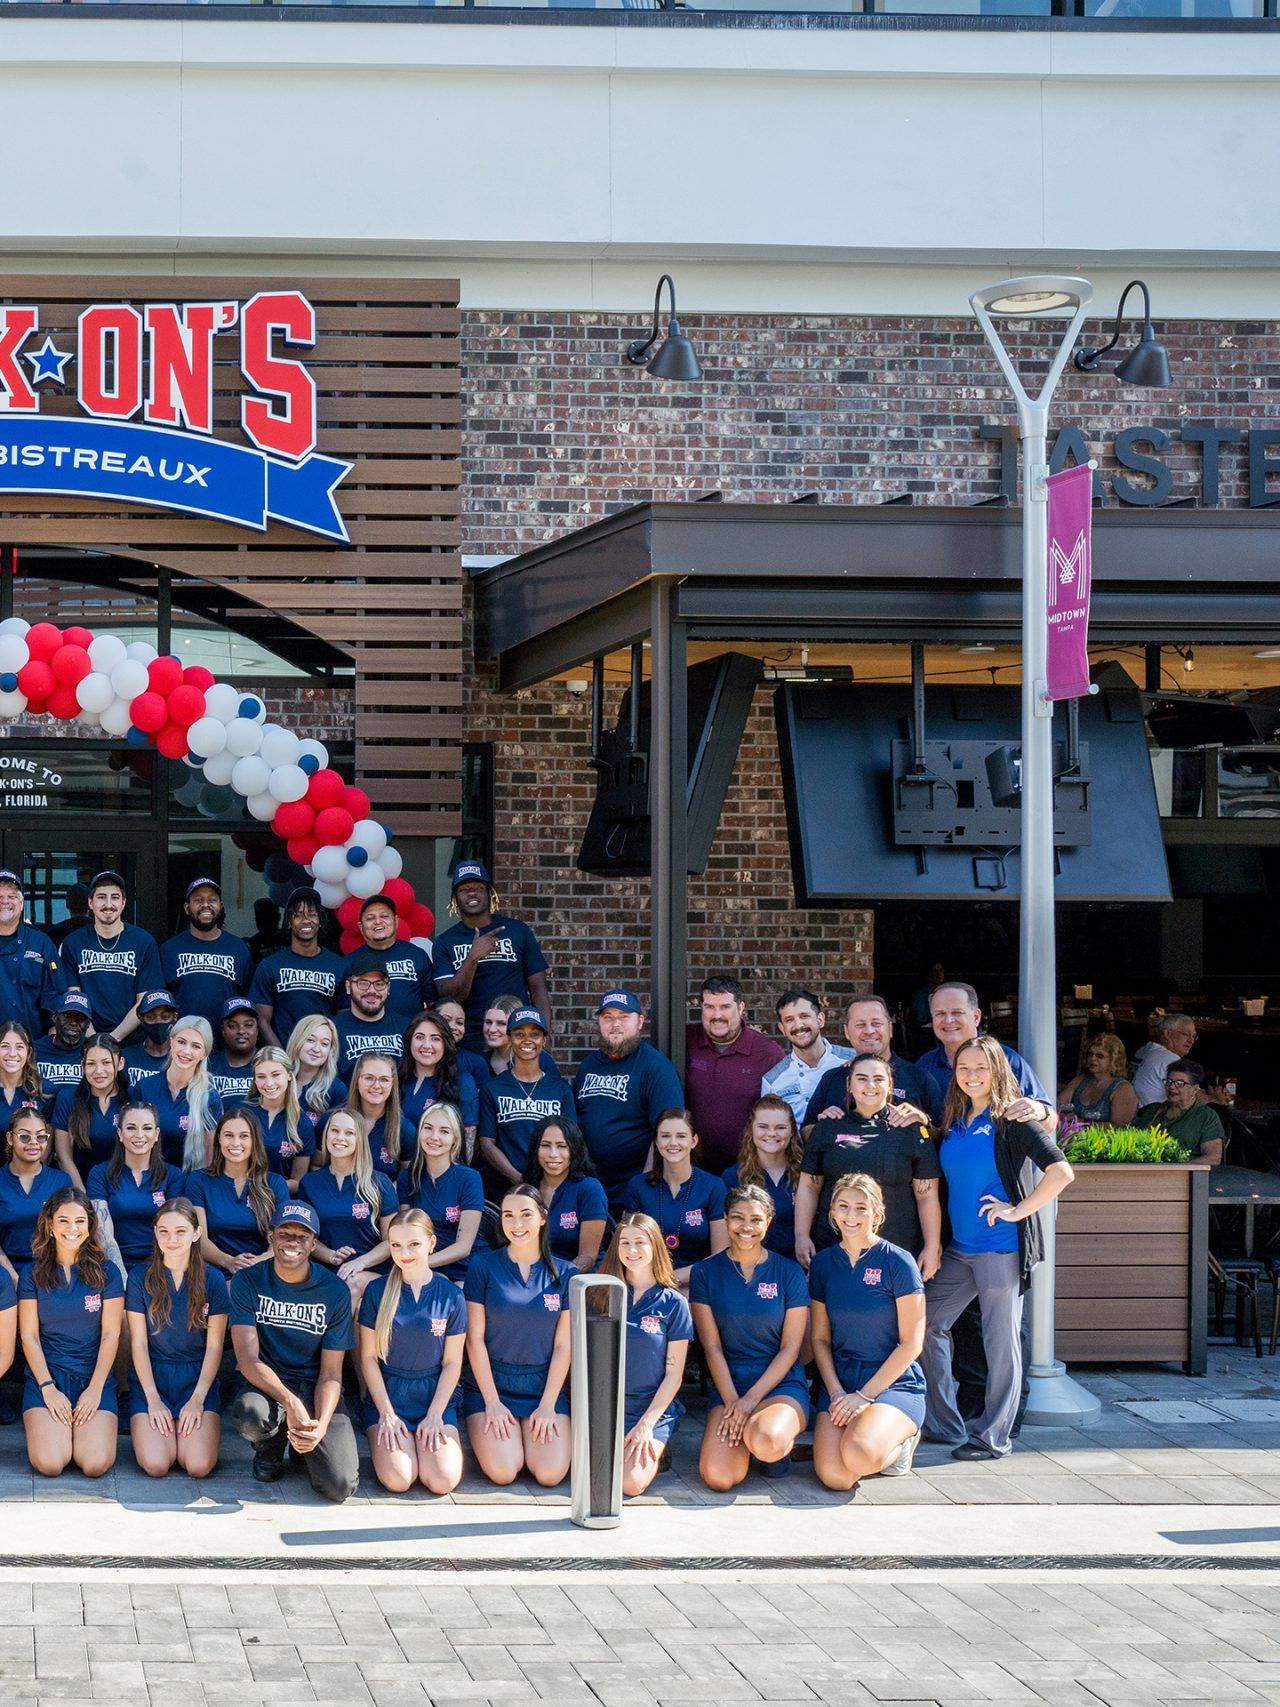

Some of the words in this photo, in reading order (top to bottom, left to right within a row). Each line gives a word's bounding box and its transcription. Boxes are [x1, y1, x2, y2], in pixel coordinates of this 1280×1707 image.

[1048, 608, 1086, 624] MIDTOWN
[41, 767, 62, 785] TO
[5, 795, 48, 806] FLORIDA
